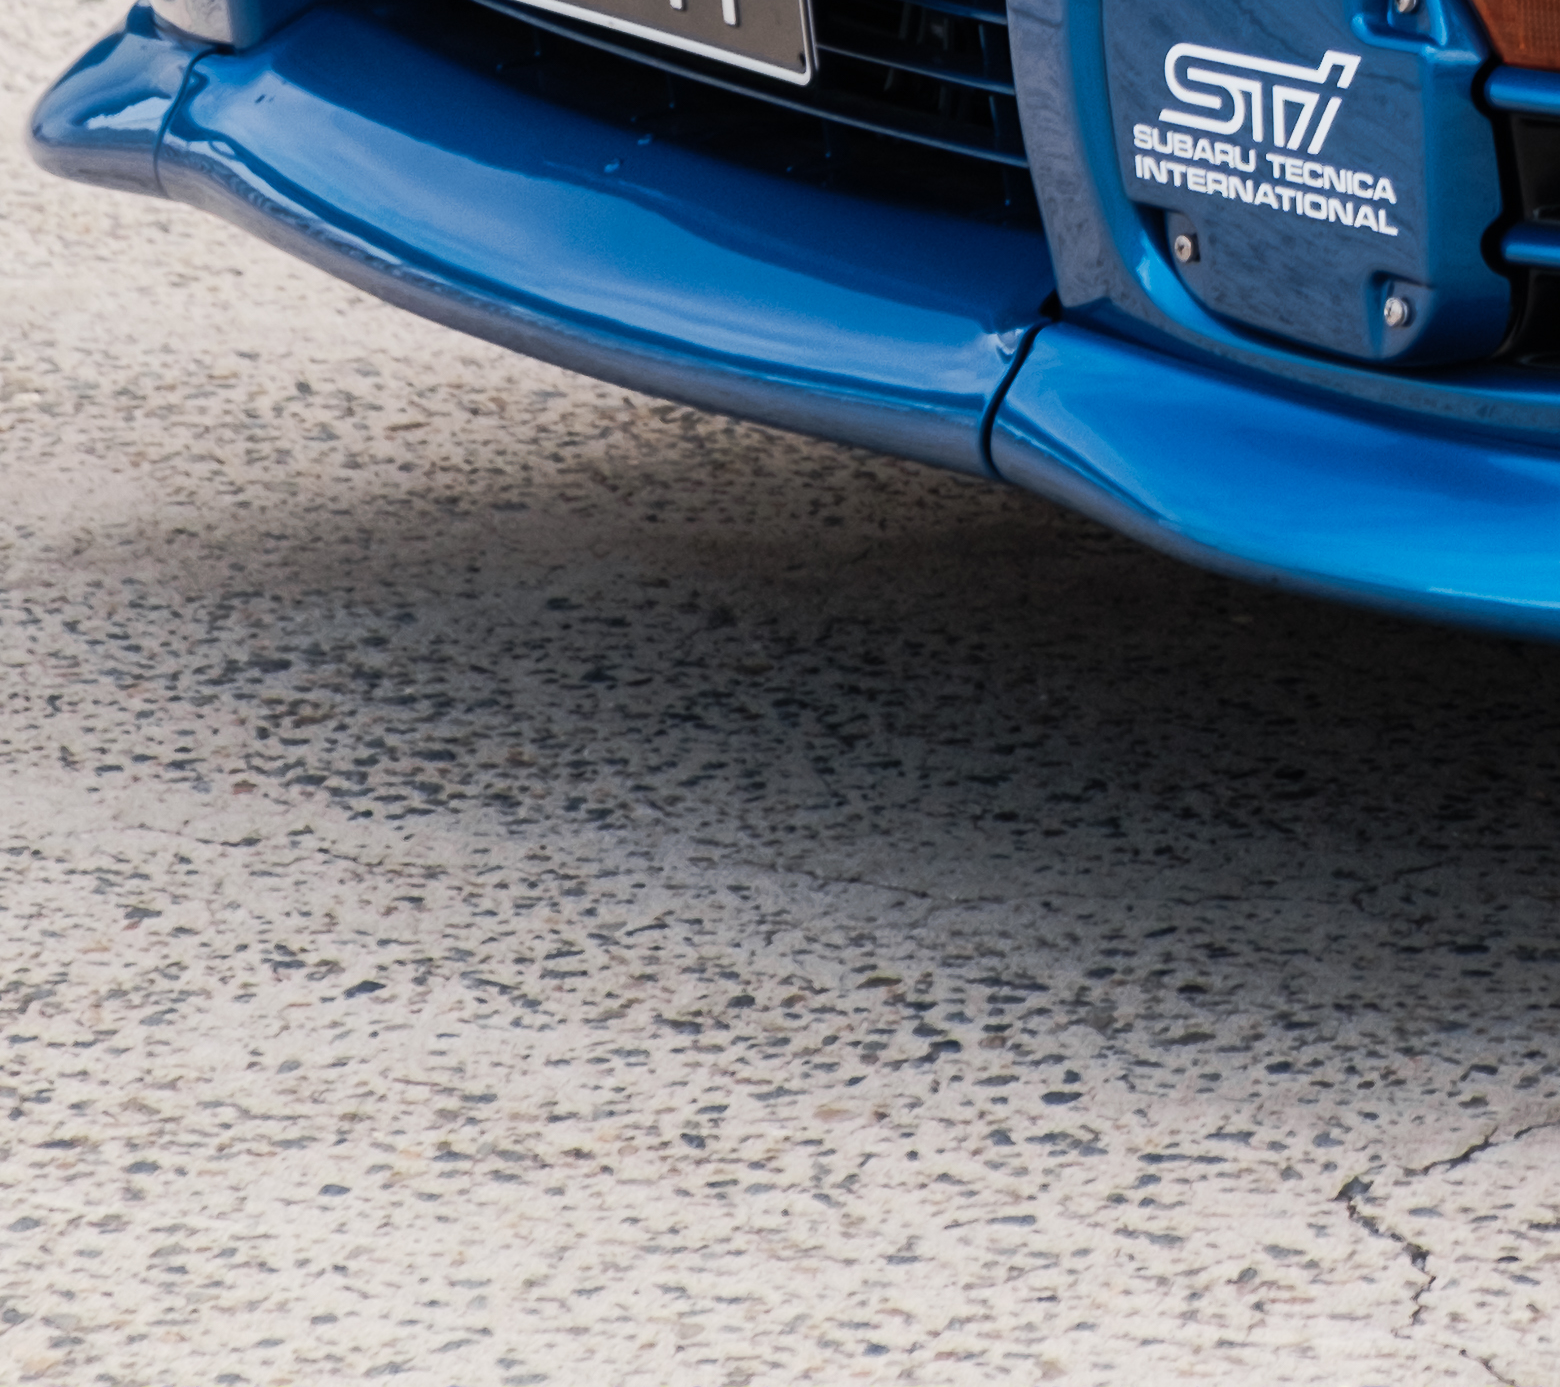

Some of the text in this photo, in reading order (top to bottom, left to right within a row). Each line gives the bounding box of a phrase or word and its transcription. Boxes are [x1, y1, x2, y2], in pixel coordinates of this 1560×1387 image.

[1133, 124, 1398, 205] SUBARU TECNICA
[1134, 155, 1398, 236] INTERNATIONAL
